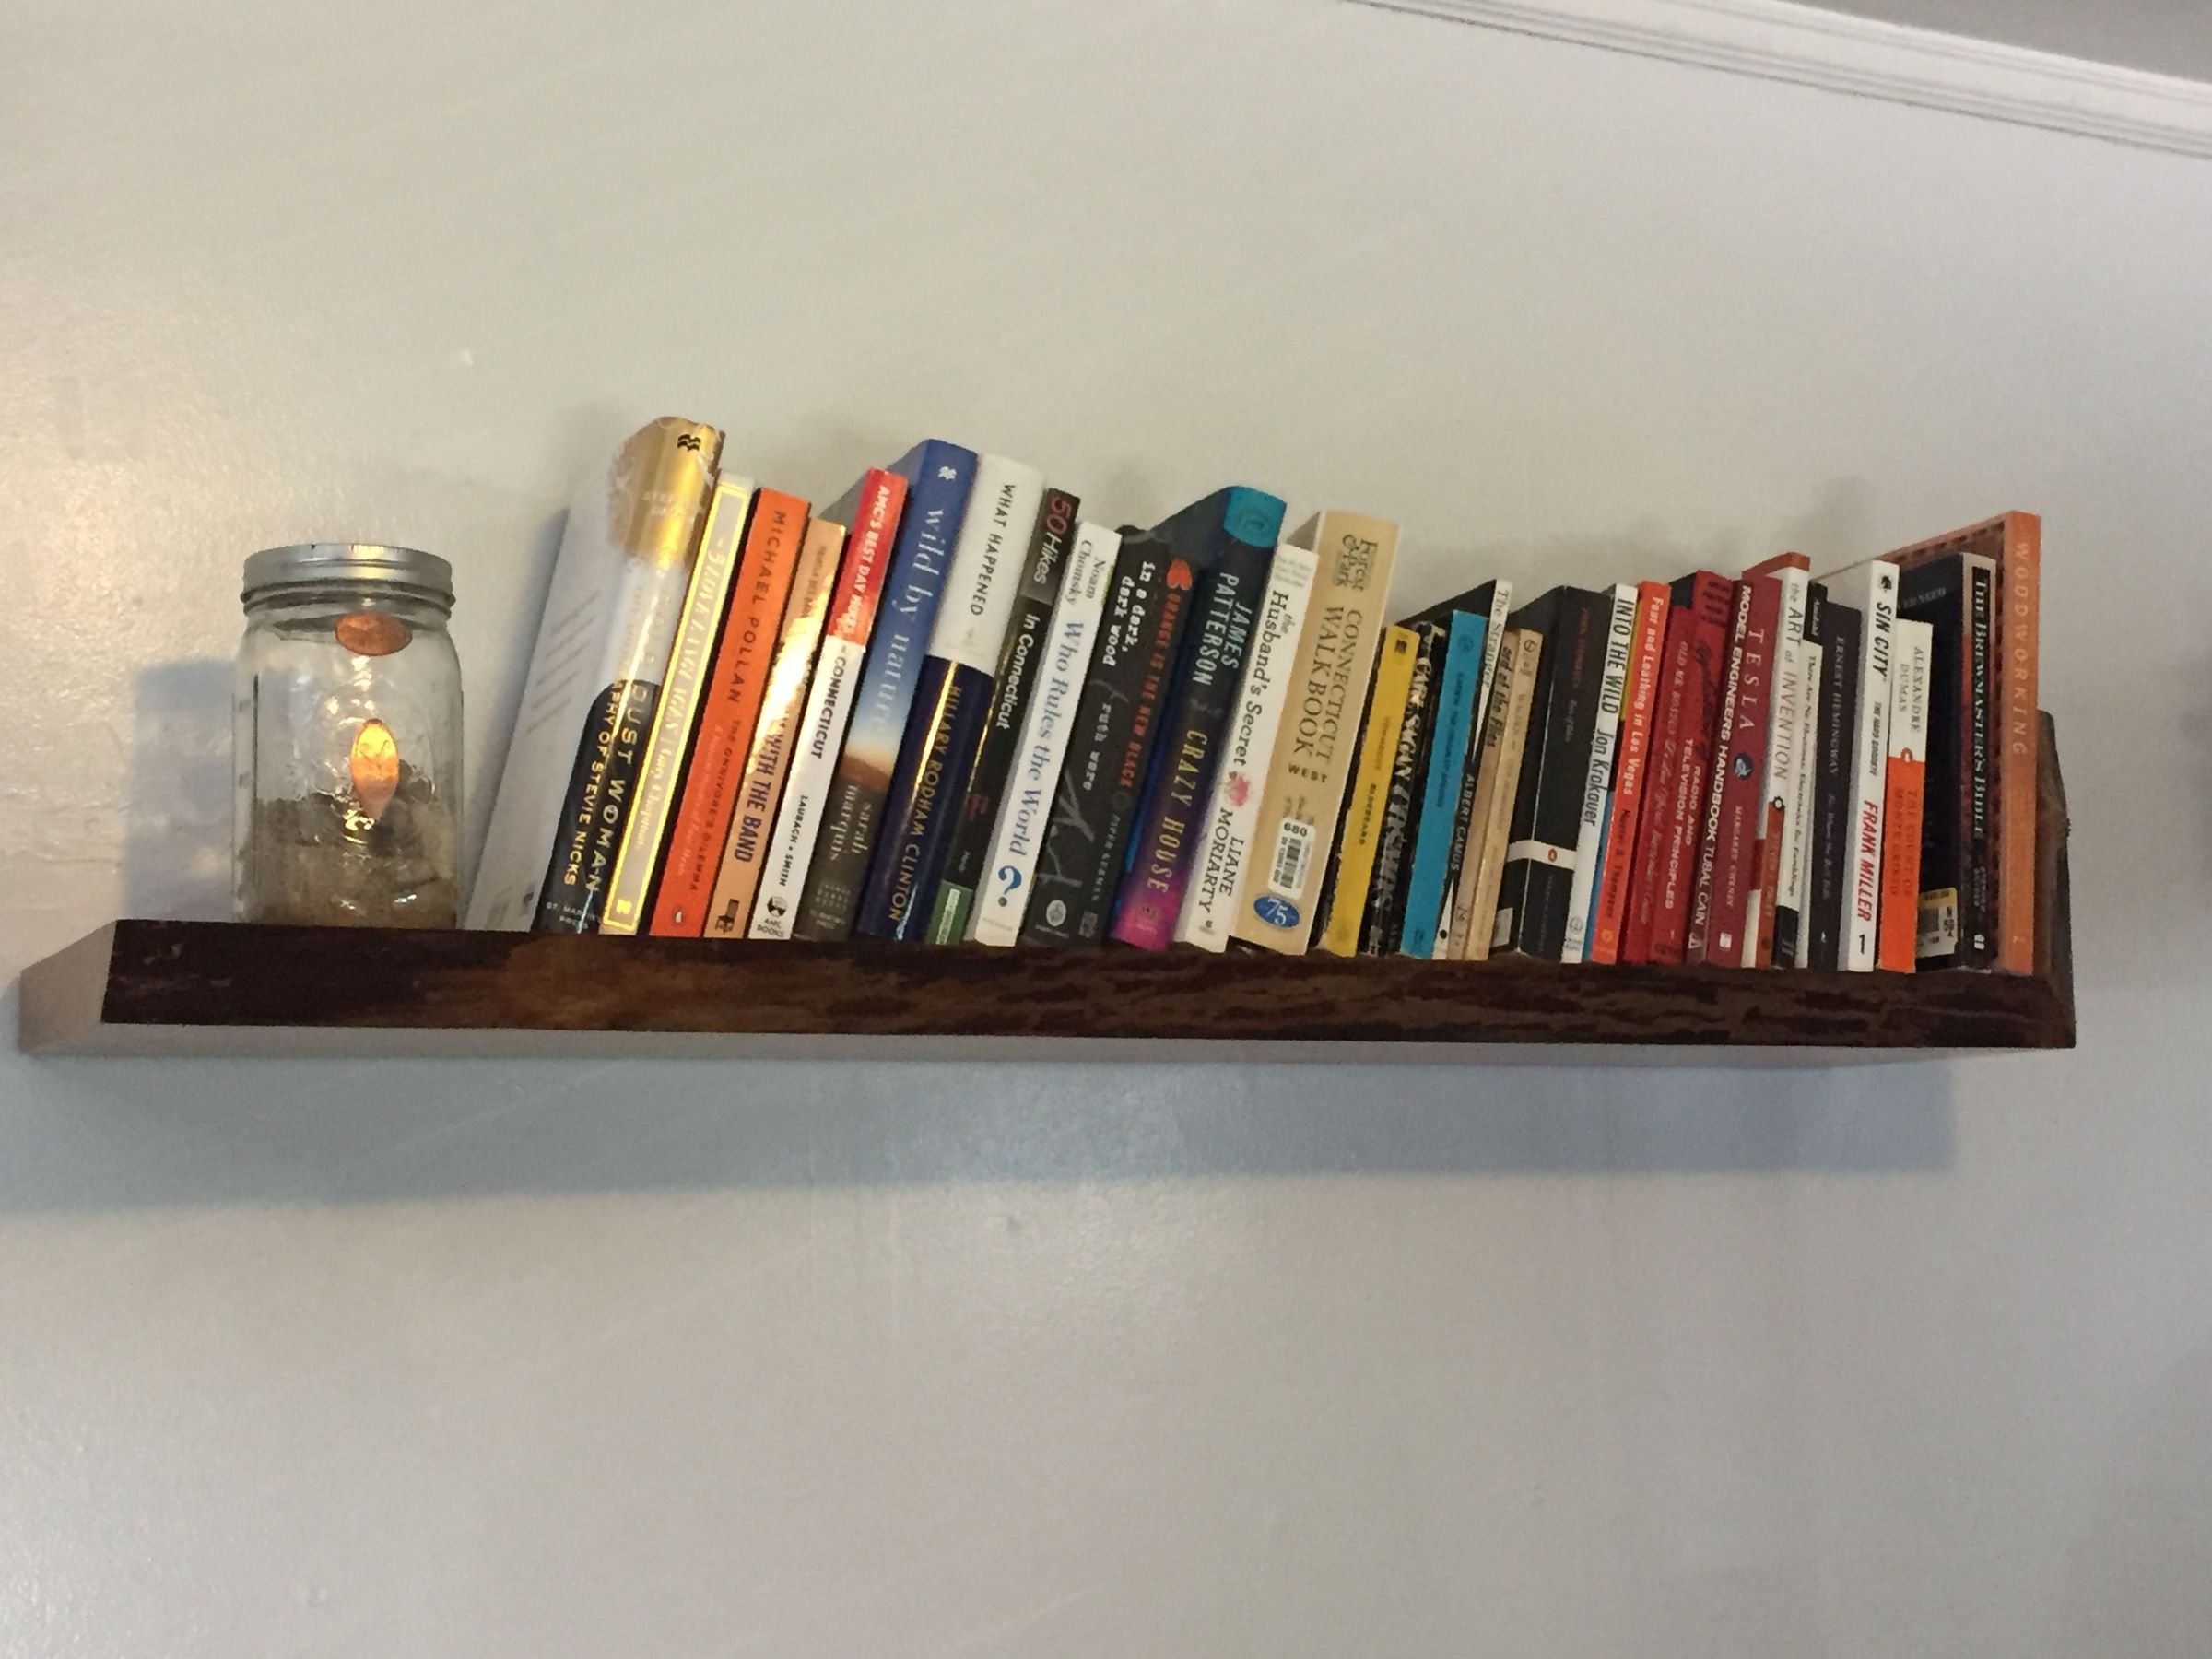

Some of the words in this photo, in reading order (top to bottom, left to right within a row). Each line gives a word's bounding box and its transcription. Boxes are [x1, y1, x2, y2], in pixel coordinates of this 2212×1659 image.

[868, 484, 890, 528] AMC'S
[992, 481, 1016, 525] WHAT
[1043, 496, 1073, 535] 50
[750, 510, 787, 607] MICHAEL
[860, 530, 878, 562] BEST
[911, 504, 955, 574] wild
[1032, 530, 1064, 586] Hikes
[853, 564, 869, 593] DAY
[968, 531, 1002, 615] HAPPENED
[1064, 537, 1093, 606] Chomsky
[1084, 556, 1105, 600] Noam
[1134, 587, 1147, 599] a
[1138, 560, 1155, 582] in
[1788, 582, 1802, 603] the
[888, 580, 935, 623] by
[1112, 574, 1135, 618] dark
[1154, 592, 1181, 649] ORANGE
[1493, 588, 1510, 618] The
[1611, 598, 1634, 636] INTO
[1648, 595, 1664, 624] Fear
[1733, 585, 1750, 643] MODEL
[1874, 601, 1891, 632] SIN
[1974, 580, 1987, 618] THE
[1022, 613, 1040, 631] In
[1053, 618, 1084, 675] Who
[1101, 623, 1124, 666] wood
[1120, 602, 1146, 653] dark,
[1191, 571, 1240, 686] PATTERSON
[1219, 600, 1253, 670] JAMES
[1248, 590, 1290, 698] Husband's
[1279, 612, 1297, 636] the
[1311, 603, 1344, 677] WALK
[1644, 627, 1658, 651] and
[1785, 606, 1803, 646] ART
[726, 615, 760, 704] POLLAN
[1148, 653, 1164, 668] IS
[1480, 621, 1503, 689] Stranger
[1606, 641, 1628, 670] THE
[1783, 650, 1794, 663] of
[1832, 636, 1844, 688] ERNEST
[1871, 635, 1889, 677] CITY
[2012, 543, 2029, 755] WOODWORKING
[866, 629, 915, 738] nature
[994, 631, 1035, 730] Connecticut
[1140, 673, 1159, 700] THE
[1314, 608, 1363, 765] CONNECTICUT
[1491, 690, 1509, 714] the
[1599, 674, 1623, 715] WILD
[1633, 654, 1654, 710] Loathing
[1720, 646, 1743, 741] ENGINEERS
[1738, 627, 1764, 731] TESLA
[1898, 663, 1910, 712] DUMAS
[1909, 646, 1924, 732] ALEXANDRE
[613, 682, 649, 765] DUST
[809, 654, 847, 759] CONNECTICUT
[932, 683, 962, 754] HILLARY
[1037, 677, 1069, 741] Rules
[1093, 702, 1113, 744] ruth
[1132, 705, 1151, 737] NEW
[1293, 679, 1326, 757] BOOK
[1632, 713, 1645, 726] in
[1772, 671, 1796, 780] INVENTION
[594, 729, 612, 757] OF
[1232, 700, 1264, 768] Secret
[1485, 715, 1504, 748] Flies
[1593, 728, 1613, 755] Jon
[1629, 731, 1643, 752] Las
[1828, 691, 1841, 776] HEMINGWAY
[1026, 743, 1053, 782] the
[1119, 740, 1142, 788] BLACK
[1168, 727, 1208, 808] CRAZY
[1288, 764, 1328, 783] WEST
[1621, 756, 1640, 795] Vegas
[1675, 736, 1693, 820] TELEVISION
[578, 760, 605, 824] STEVIE
[746, 777, 771, 811] THE
[909, 759, 942, 838] RODHAM
[1458, 773, 1475, 823] ALBERT
[1583, 759, 1610, 828] Krakauer
[1688, 765, 1700, 810] RADIO
[1706, 744, 1729, 841] HANDBOOK
[1906, 789, 1917, 818] THE
[1974, 775, 1985, 838] BIBLE
[584, 776, 626, 892] WOMAN
[788, 794, 808, 842] LAUBACH
[822, 781, 865, 863] marquis
[850, 801, 879, 855] sarah
[1007, 785, 1041, 855] World
[1283, 821, 1309, 838] 680
[1683, 815, 1694, 846] AND
[1861, 799, 1878, 855] FRANK
[1892, 787, 1904, 839] MONTE
[562, 829, 587, 887] NICKS
[733, 814, 761, 862] BAND
[1145, 816, 1184, 893] HOUSE
[1196, 806, 1234, 912] MORIARTY
[1450, 825, 1465, 871] CAMUS
[776, 853, 793, 887] SMITH
[887, 842, 921, 922] CLINTON
[1218, 835, 1244, 897] LIANE
[1664, 825, 1683, 909] PRINCIPLES
[1699, 845, 1714, 888] TUBAL
[1856, 858, 1875, 922] MILLER
[756, 924, 784, 939] BOOKS
[1266, 898, 1288, 925] 75
[1694, 891, 1708, 925] CAIN
[1858, 933, 1866, 955] 1
